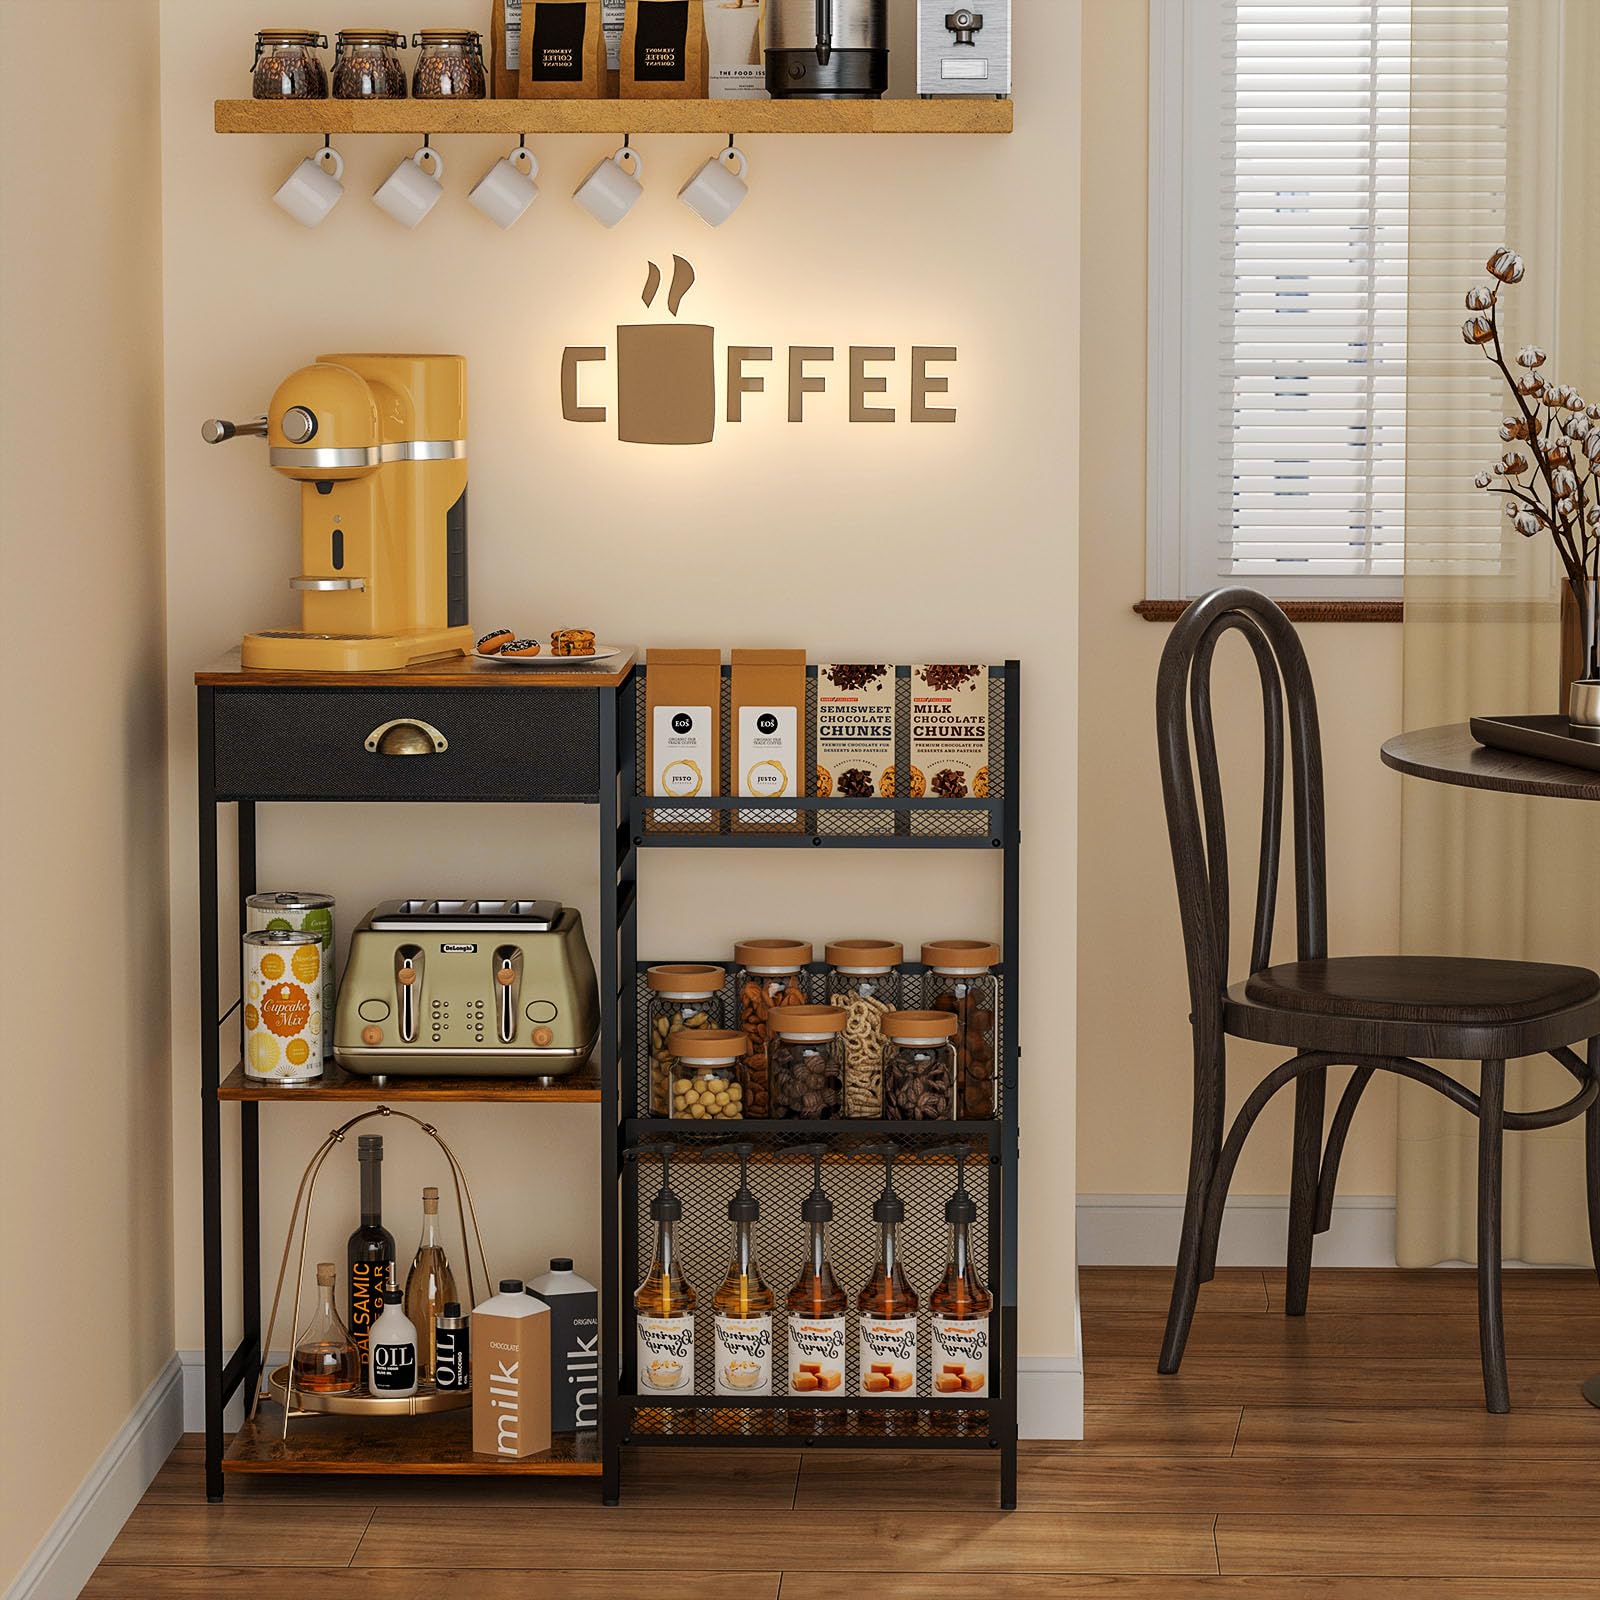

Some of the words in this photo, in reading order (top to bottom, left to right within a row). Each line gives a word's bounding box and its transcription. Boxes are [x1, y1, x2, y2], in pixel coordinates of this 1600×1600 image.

[820, 706, 892, 714] SEMISWEET
[913, 705, 951, 714] MILK
[820, 726, 892, 736] CHUNKS
[913, 726, 985, 736] CHUNKS
[263, 999, 308, 1017] Cupcake
[275, 1012, 303, 1026] Mix
[353, 1263, 370, 1364] BALSAMIC
[490, 1341, 520, 1352] CHOCOLATE
[376, 1347, 413, 1366] OIL
[436, 1334, 456, 1386] OIL
[567, 1334, 598, 1427] milk
[490, 1360, 519, 1455] milk
